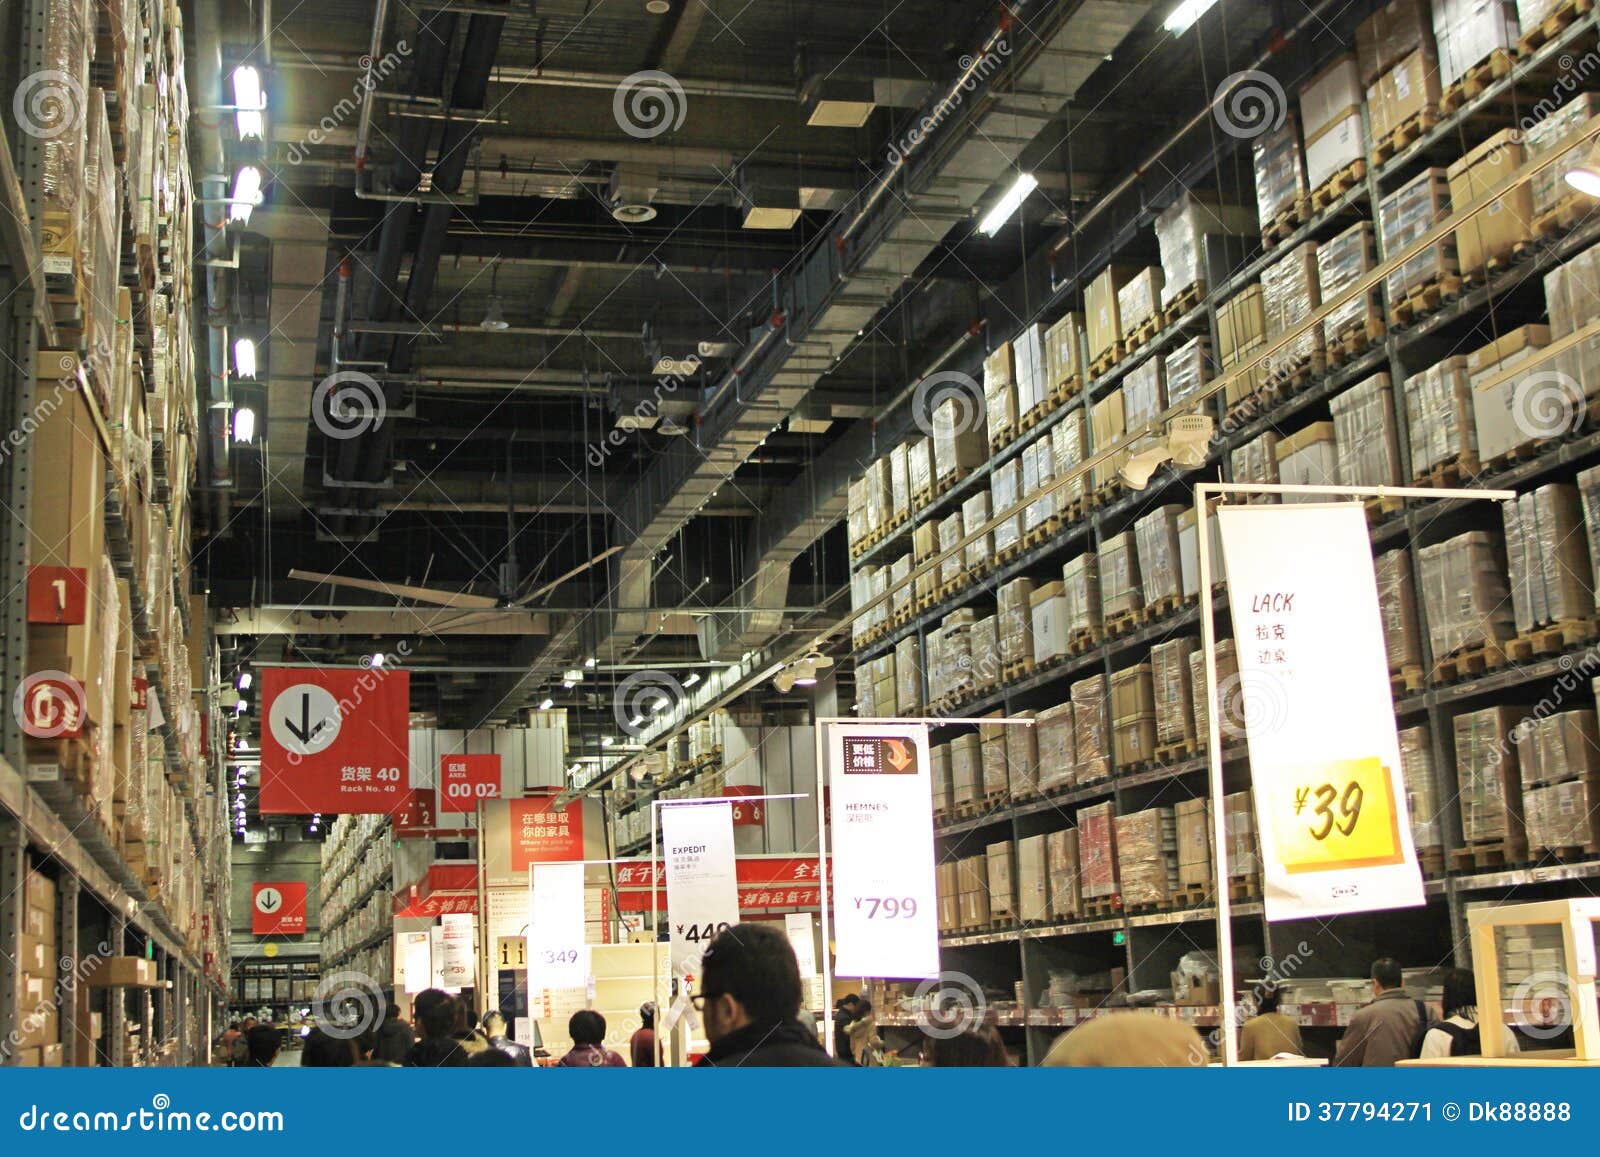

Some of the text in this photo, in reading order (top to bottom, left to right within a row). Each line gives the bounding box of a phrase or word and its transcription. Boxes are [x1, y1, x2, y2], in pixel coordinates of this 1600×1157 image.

[51, 579, 66, 610] 1
[1252, 592, 1295, 613] LACK
[1255, 624, 1285, 641] 拉克
[341, 766, 400, 782] 货架 40
[340, 785, 396, 793] Rack No. 40
[448, 783, 497, 798] 00 02
[733, 806, 742, 820] 6
[846, 803, 889, 811] HEMNES
[1294, 780, 1364, 841] ¥39
[400, 813, 409, 825] 2
[422, 811, 430, 825] 2
[522, 812, 569, 825] 在哪里取
[523, 825, 570, 838] 你的家具
[672, 845, 706, 855] EXPEDIT
